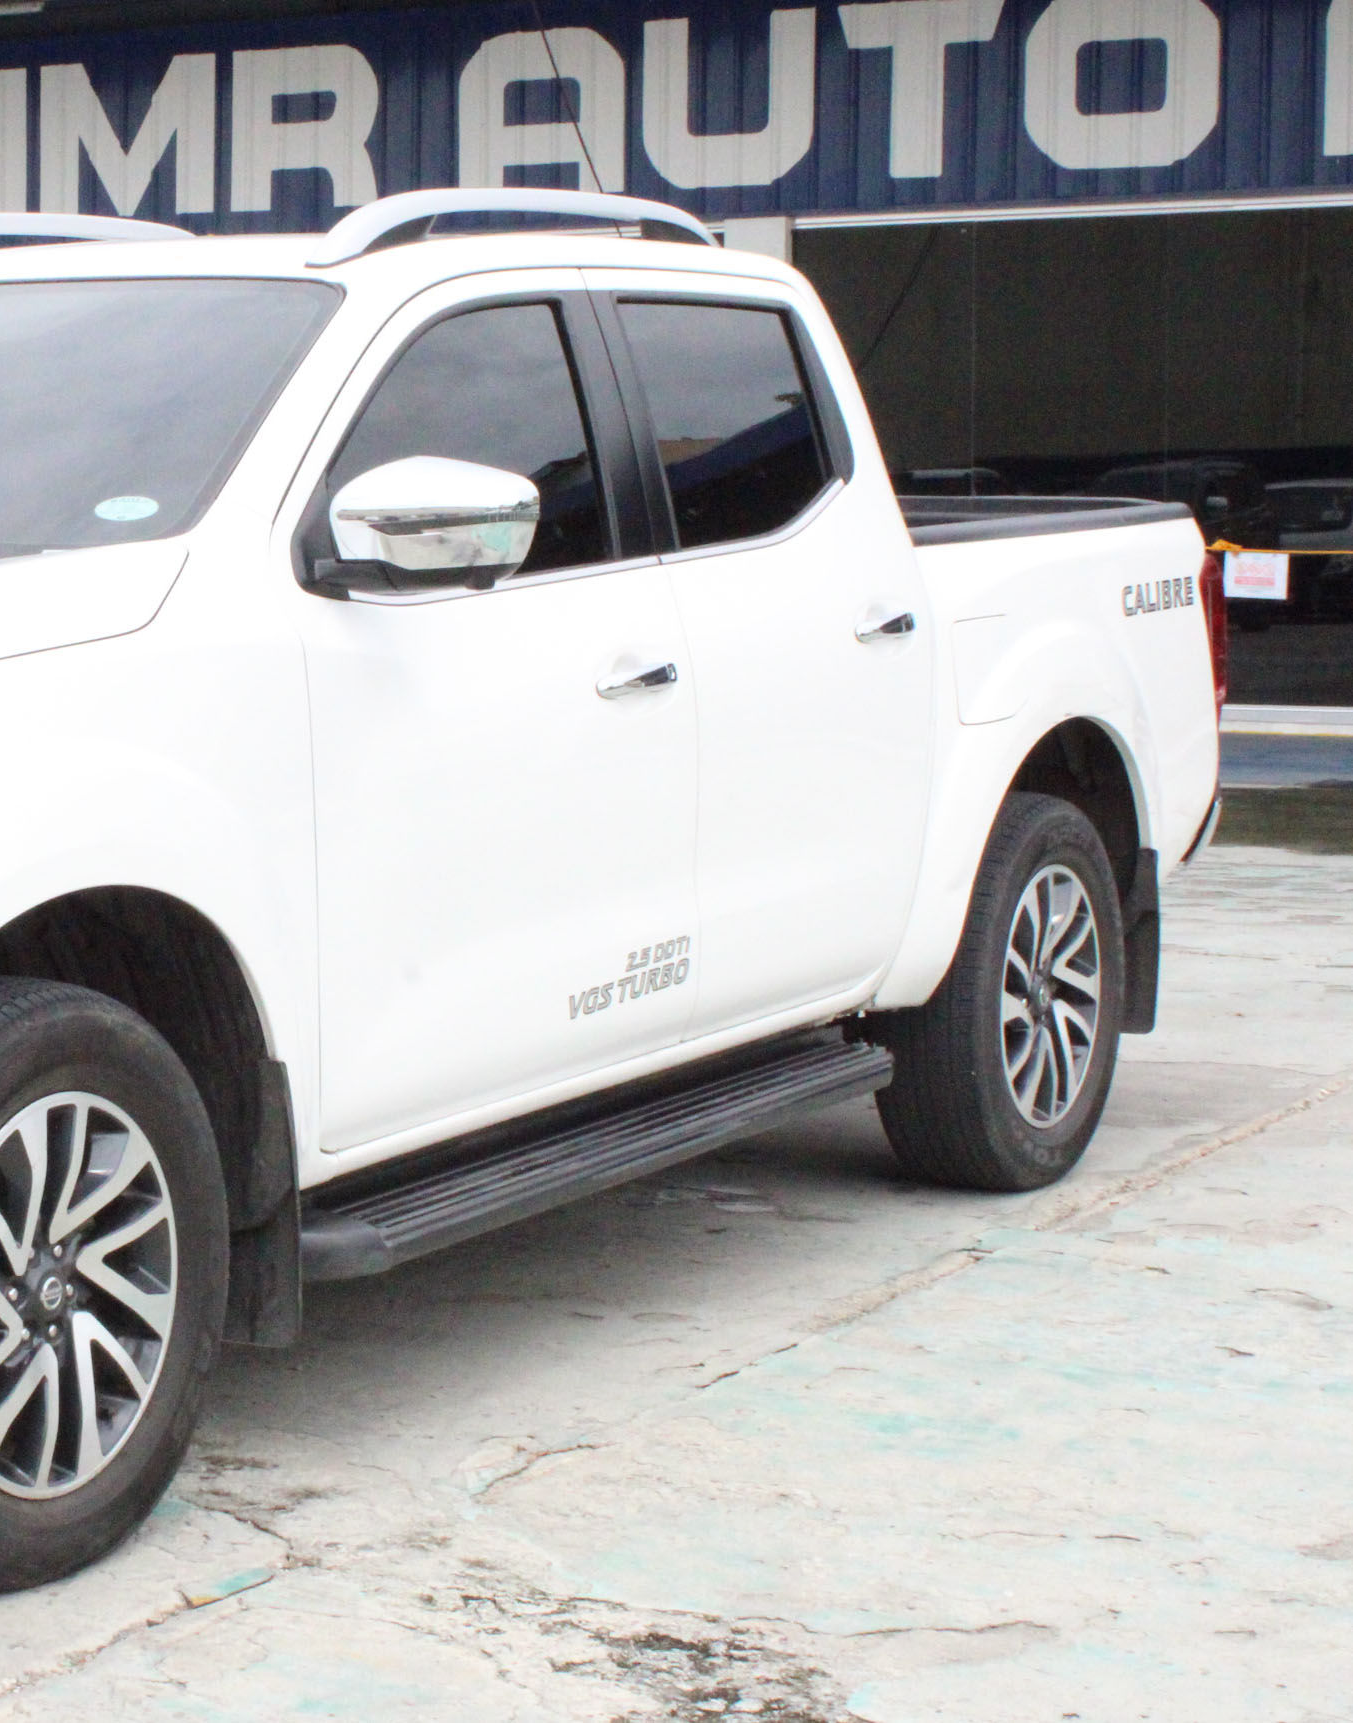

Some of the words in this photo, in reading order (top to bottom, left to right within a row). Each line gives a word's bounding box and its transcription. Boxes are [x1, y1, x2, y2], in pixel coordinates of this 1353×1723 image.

[458, 0, 1221, 192] AUTO
[1120, 575, 1195, 618] CALIBRE
[568, 981, 615, 1021] VGS
[616, 956, 691, 1005] TURBO
